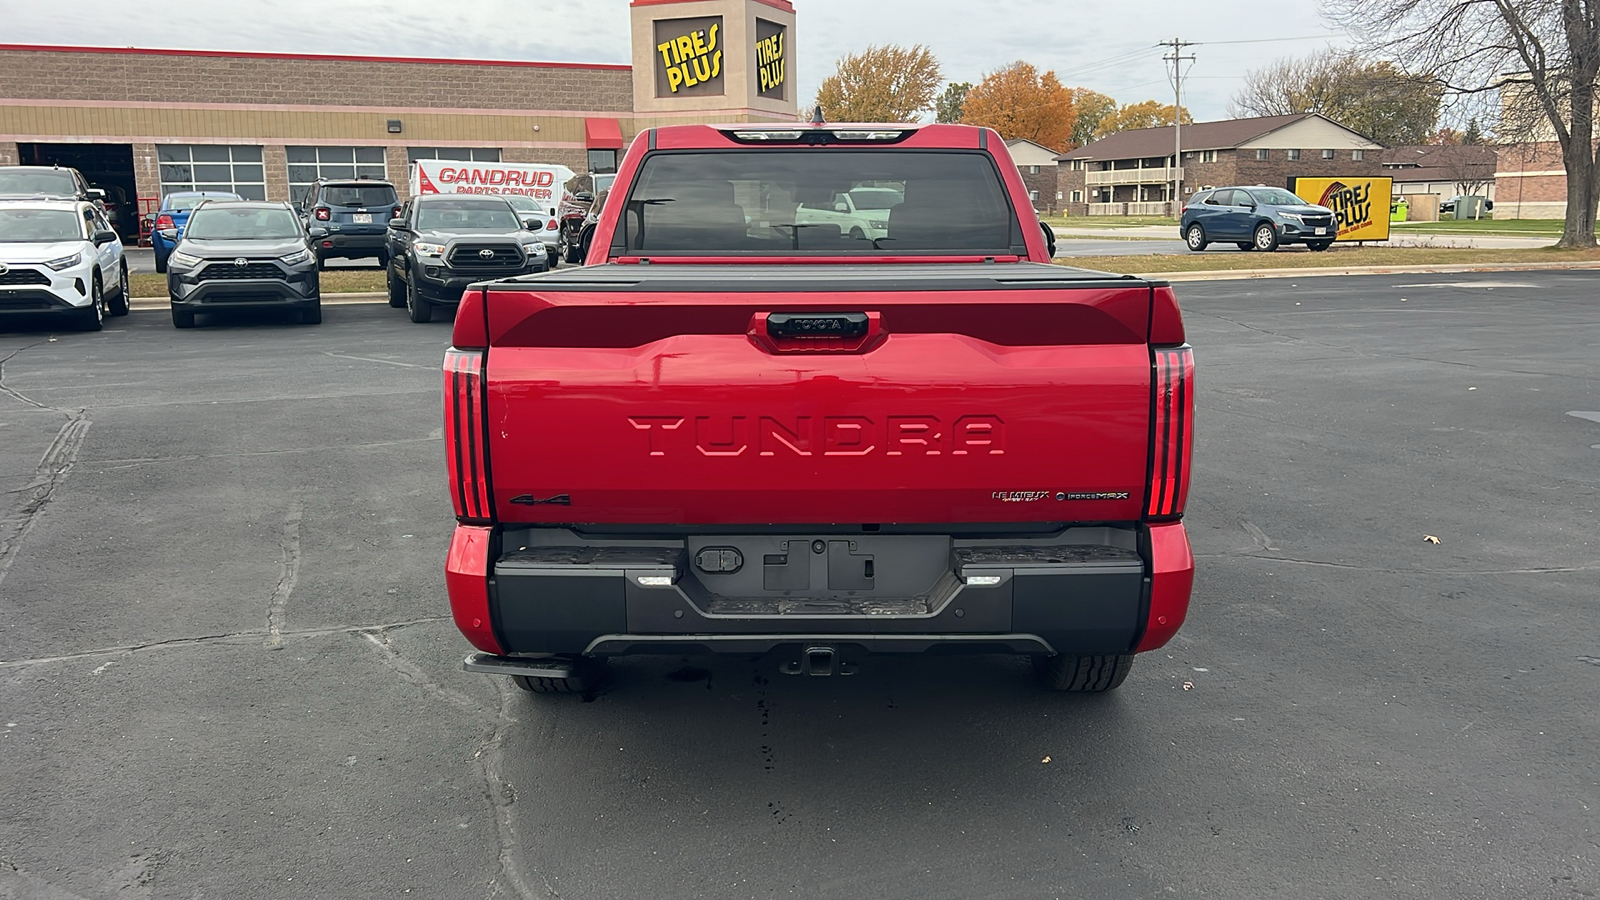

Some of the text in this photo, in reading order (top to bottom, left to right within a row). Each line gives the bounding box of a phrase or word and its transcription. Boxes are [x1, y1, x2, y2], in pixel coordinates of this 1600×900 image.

[657, 23, 719, 68] TIRES
[756, 32, 783, 67] TIRES
[666, 49, 722, 93] PLUS
[759, 58, 785, 92] PLUS
[438, 167, 554, 187] GANDRUD
[456, 186, 552, 199] PARTS CENTER
[1329, 182, 1371, 212] TIRES
[1335, 201, 1371, 231] PLUS
[794, 319, 841, 329] TOYOTA
[627, 414, 1006, 456] TUNDRA
